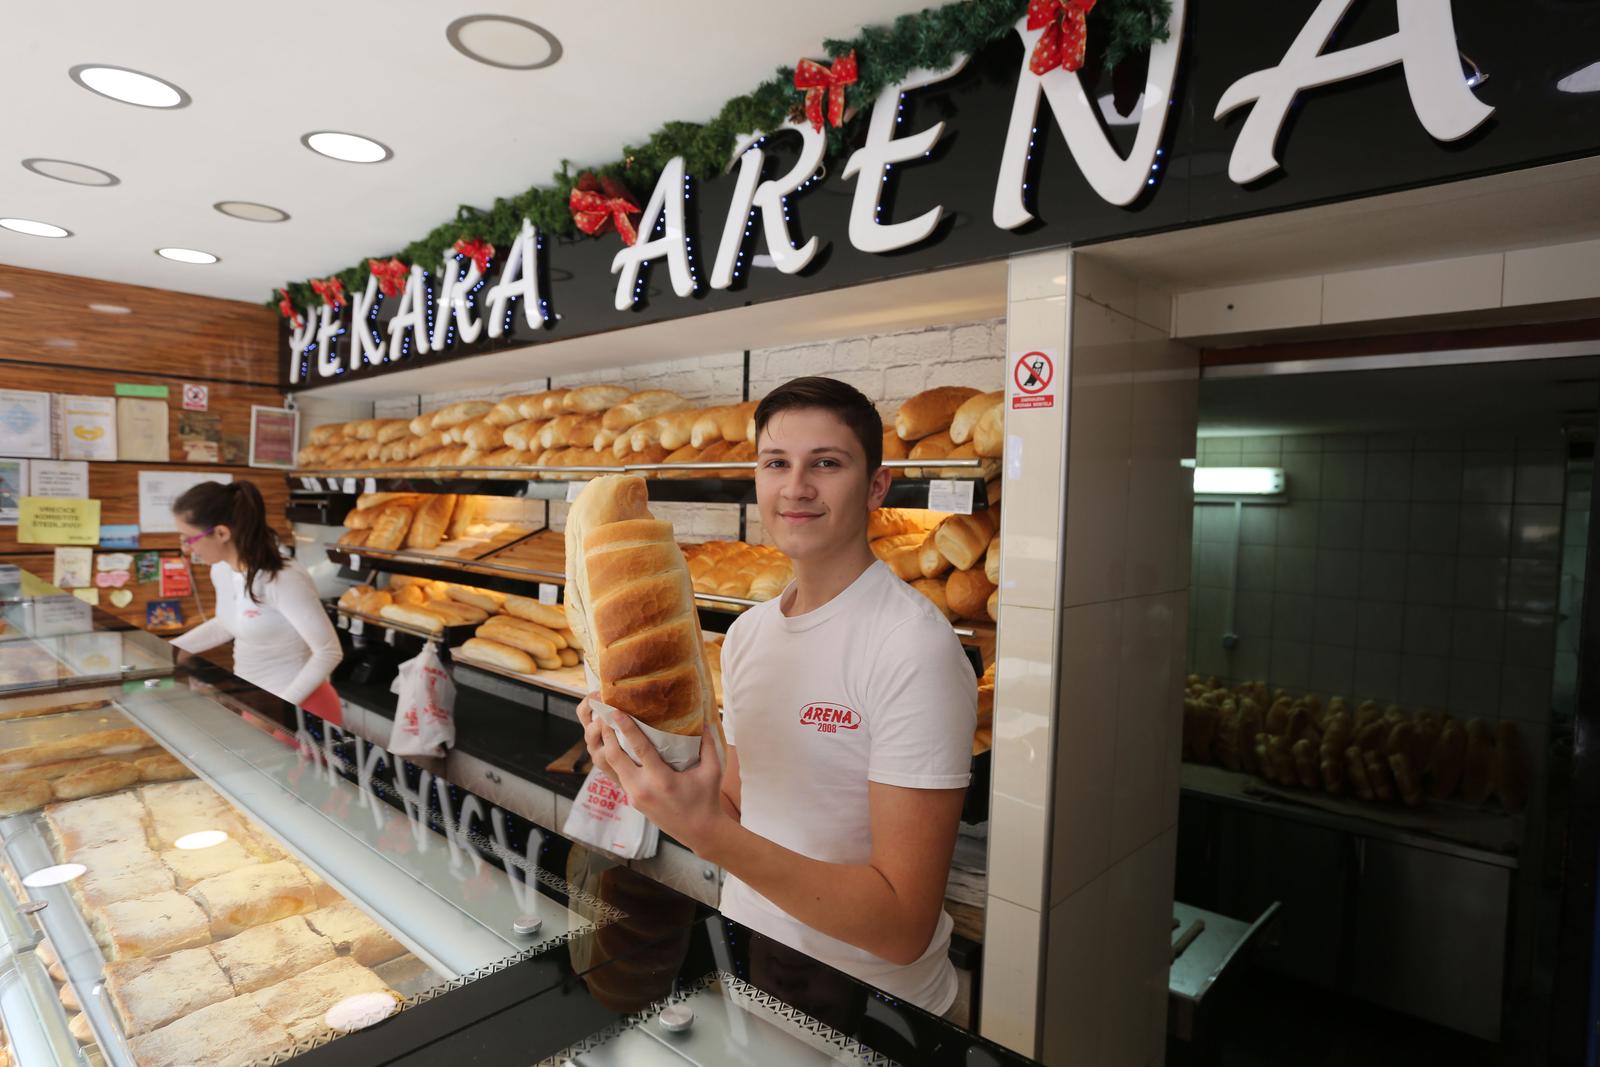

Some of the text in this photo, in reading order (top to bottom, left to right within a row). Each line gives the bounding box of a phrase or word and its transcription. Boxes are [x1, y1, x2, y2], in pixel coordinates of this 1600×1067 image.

[289, 0, 1496, 384] PEKARA ARENA
[803, 706, 852, 724] ARENA
[817, 722, 837, 734] 2008
[587, 782, 629, 806] RENA
